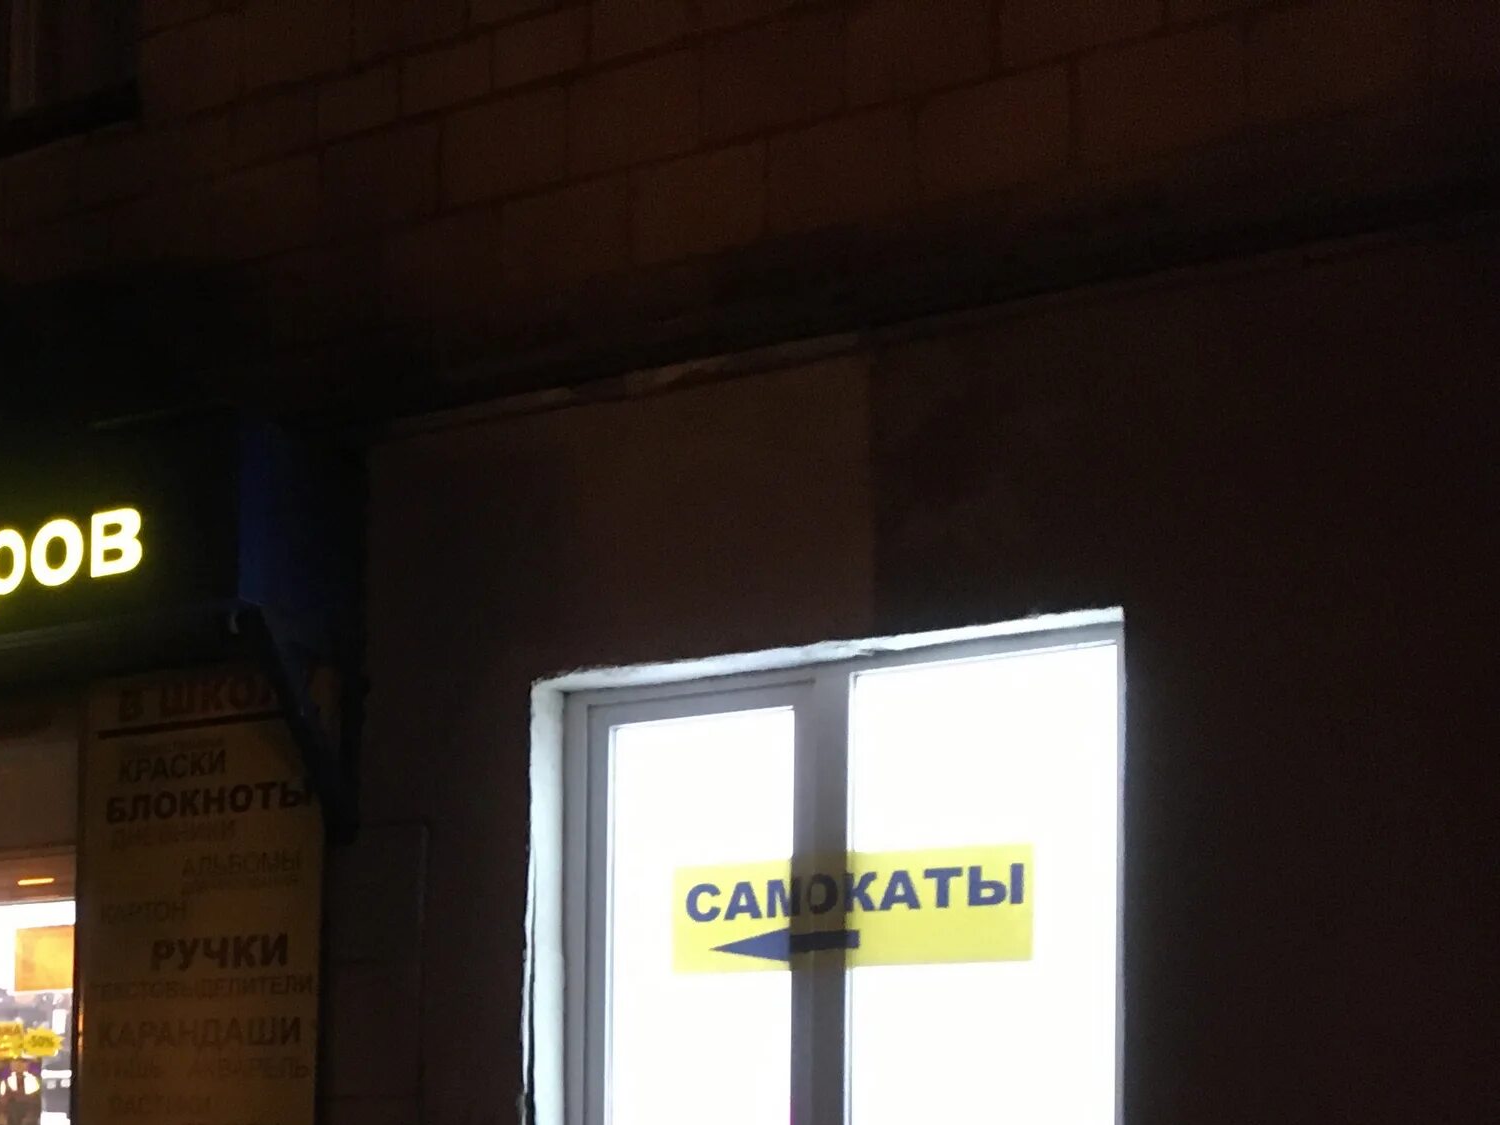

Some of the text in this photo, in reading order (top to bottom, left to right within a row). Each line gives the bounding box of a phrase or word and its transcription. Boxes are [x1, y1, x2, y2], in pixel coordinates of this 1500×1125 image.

[118, 750, 227, 784] КРАСКИ
[106, 782, 313, 824] БЛОКНОТЫ
[181, 849, 302, 878] АЛЬБОМЫ
[685, 862, 1026, 923] САМОКАТЫ
[100, 900, 188, 925] КАРТОН
[151, 931, 289, 972] РУЧКИ
[93, 974, 314, 1002] ТЕКСТОВЫДЕЛИТЕЛИ
[98, 1016, 301, 1050] КАРАНДАШИ
[186, 1056, 309, 1080] АКВАРЕЛЬ
